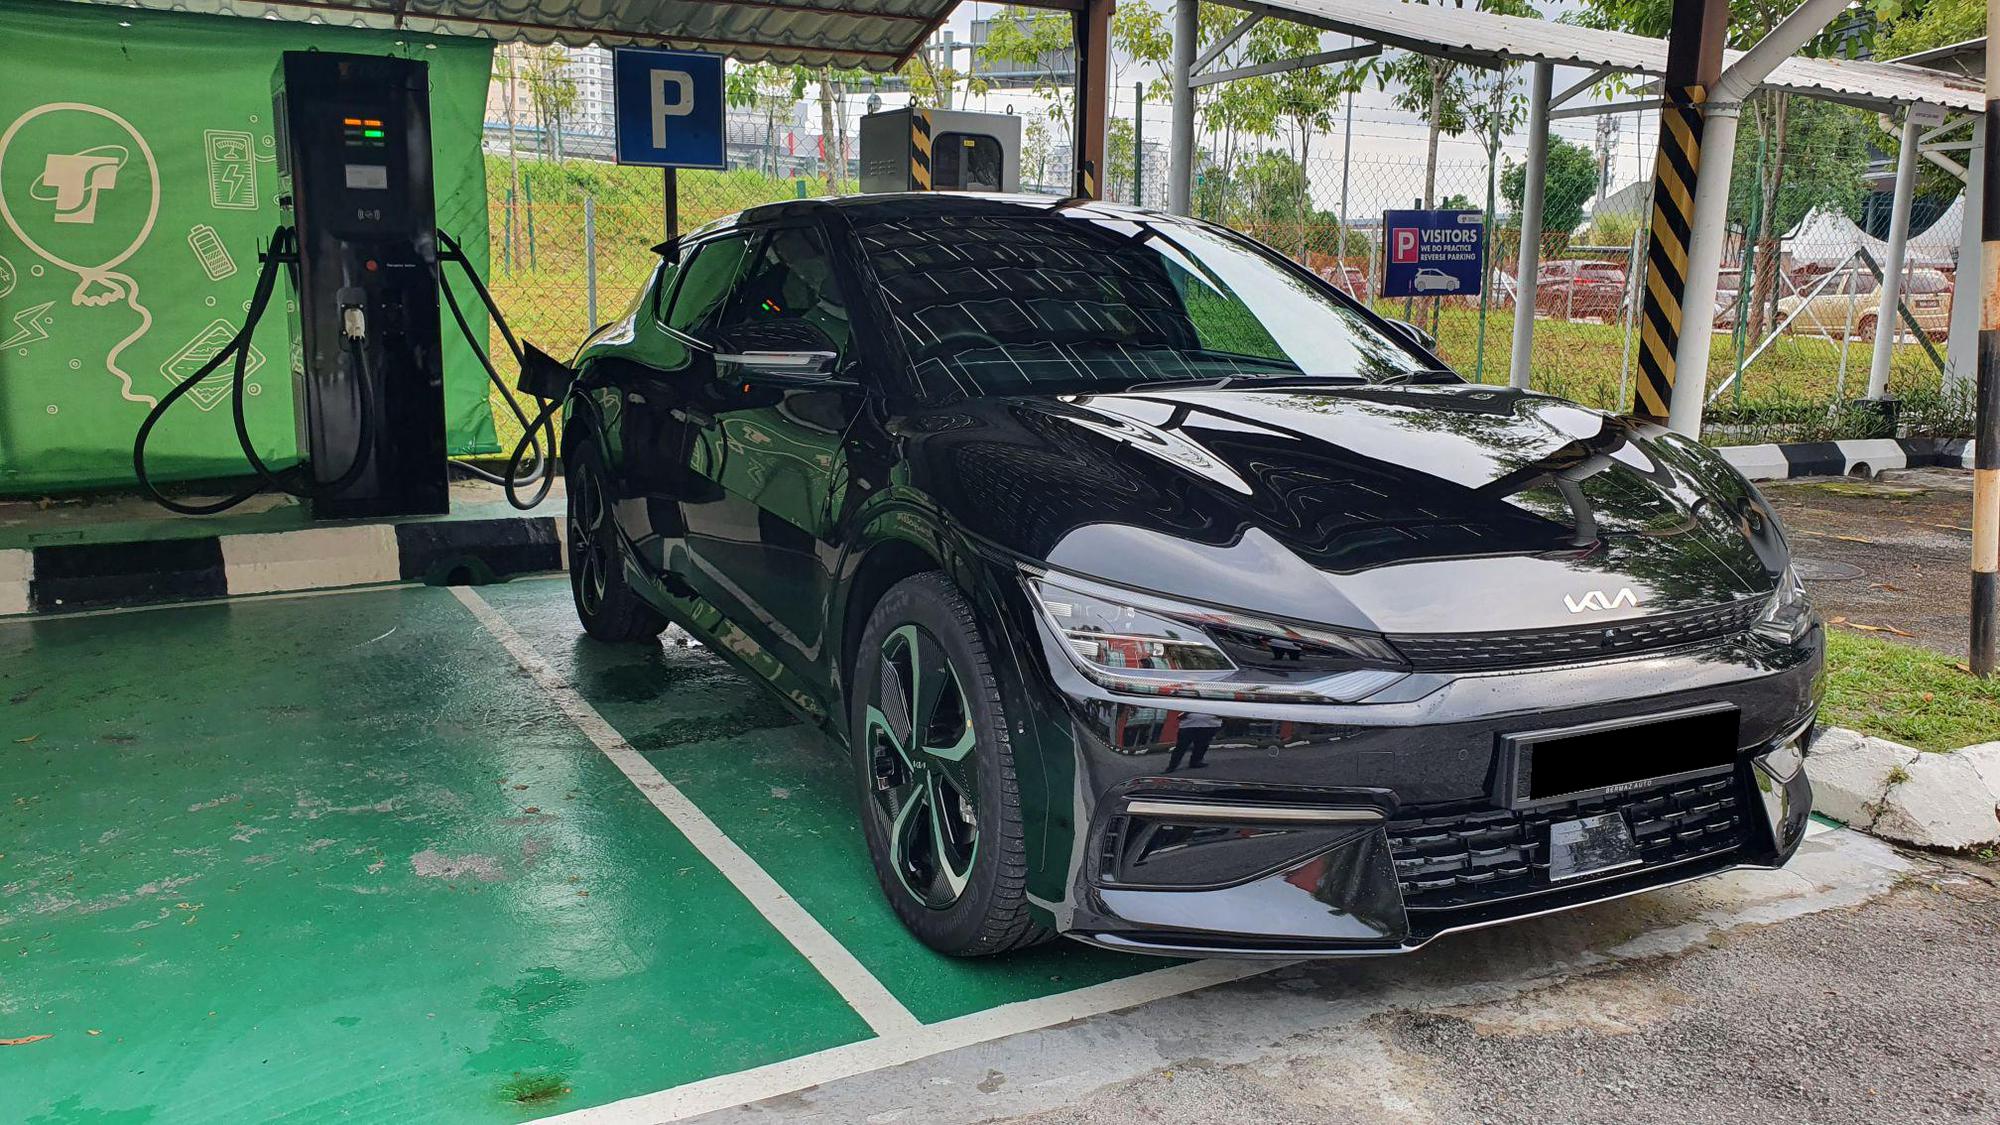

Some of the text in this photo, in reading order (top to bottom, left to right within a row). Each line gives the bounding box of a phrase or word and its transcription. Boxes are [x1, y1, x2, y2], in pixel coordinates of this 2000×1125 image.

[650, 69, 694, 149] P
[1398, 231, 1415, 260] P
[1421, 229, 1477, 243] VISITORS
[1443, 244, 1472, 252] PRACTICE
[1563, 587, 1638, 614] KIA
[1605, 780, 1652, 794] BERMAZ AUTO
